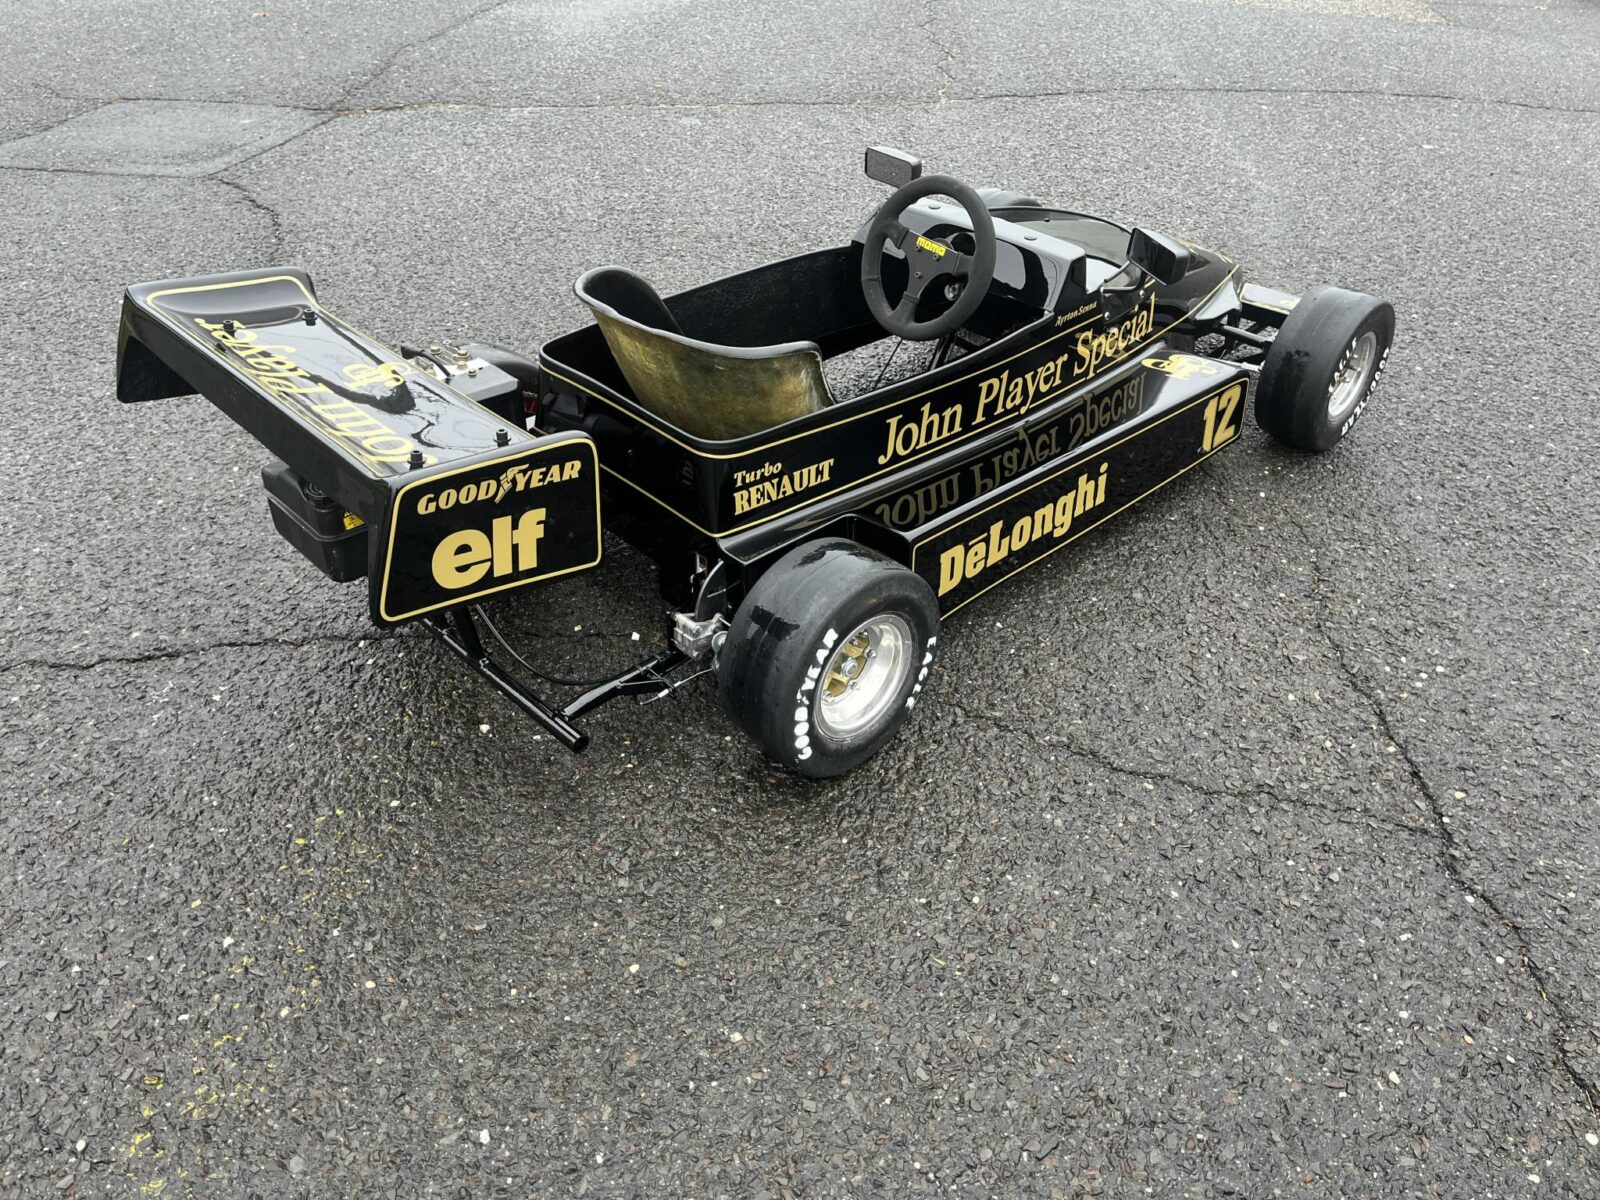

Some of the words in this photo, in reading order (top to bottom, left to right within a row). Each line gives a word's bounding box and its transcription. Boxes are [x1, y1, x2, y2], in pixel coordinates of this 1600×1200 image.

[916, 236, 946, 257] momo
[1055, 309, 1078, 327] Ayrton
[1079, 301, 1098, 315] Senna
[878, 402, 963, 465] John
[972, 352, 1069, 415] Player
[1074, 293, 1156, 380] Special
[1202, 384, 1242, 452] 12
[734, 460, 782, 488] Turbo
[734, 458, 835, 516] RENAULT
[431, 507, 547, 590] elf
